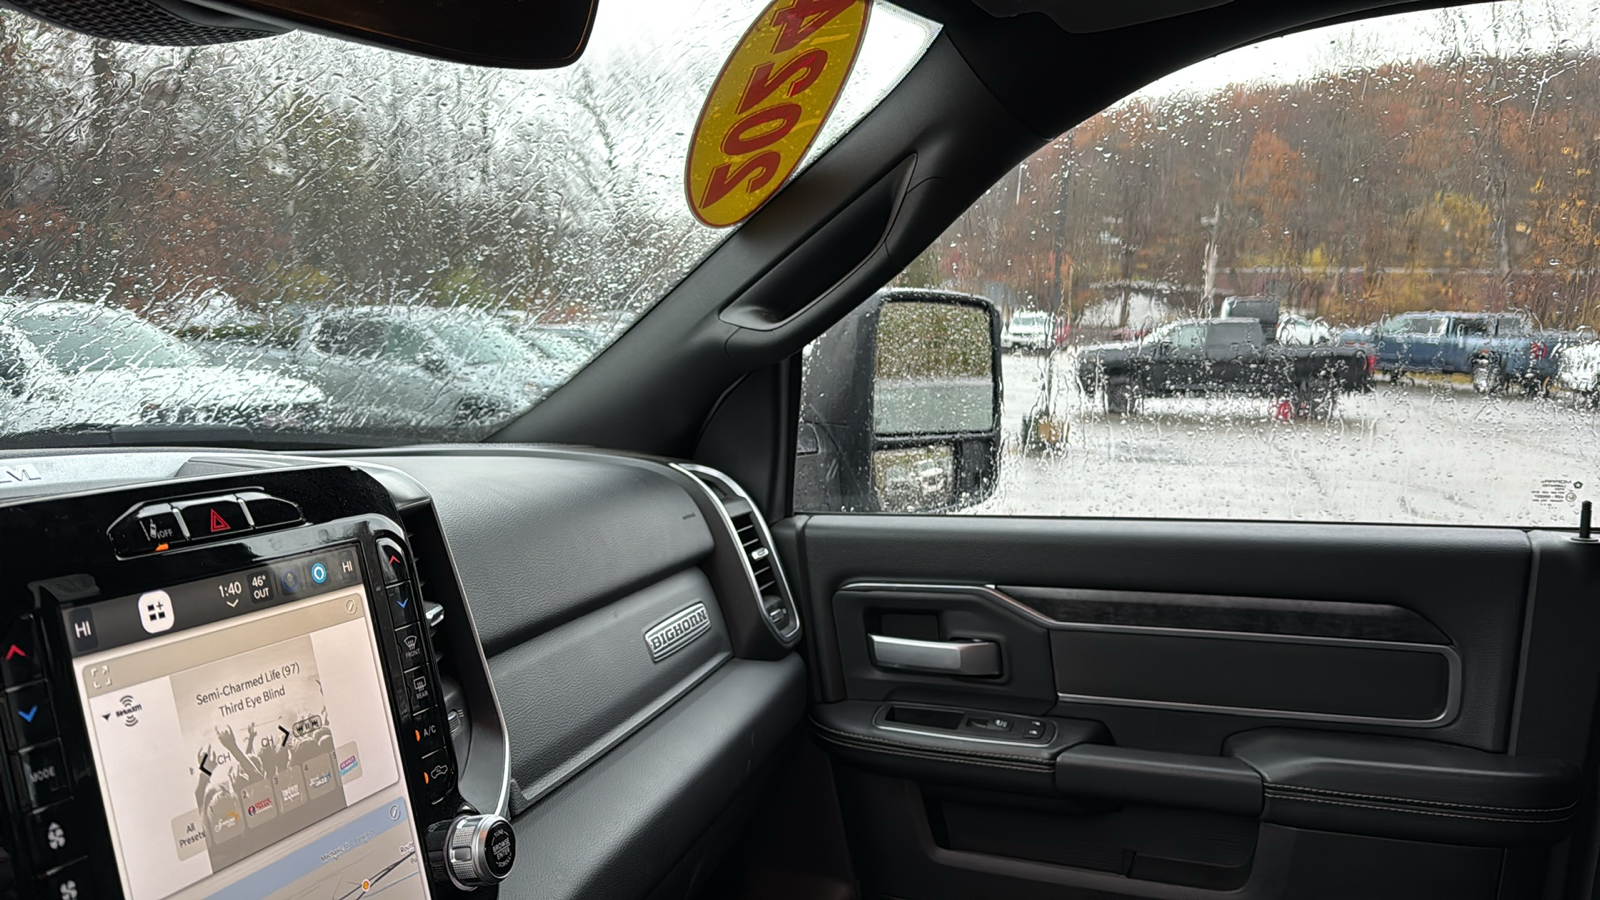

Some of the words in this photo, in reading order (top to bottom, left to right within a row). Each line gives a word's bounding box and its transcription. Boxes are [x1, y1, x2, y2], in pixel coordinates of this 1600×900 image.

[160, 528, 173, 539] OFF
[342, 560, 353, 573] HI
[219, 581, 242, 598] 1:40
[253, 587, 270, 599] OUT
[74, 620, 92, 639] HI
[650, 609, 708, 650] BIGHORN
[405, 648, 420, 658] FRONT
[195, 674, 264, 706] Semi-Charmed
[264, 669, 281, 683] Life
[281, 662, 300, 679] (97)
[218, 699, 244, 717] Third
[245, 695, 262, 709] Eye
[262, 685, 286, 702] Blind
[416, 690, 428, 700] REAR
[423, 725, 437, 737] A/C
[260, 735, 274, 748] CH
[217, 752, 231, 765] CH
[31, 766, 56, 782] MODE
[274, 777, 280, 786] 3
[242, 791, 248, 799] 2
[186, 823, 196, 834] All
[179, 830, 206, 848] Presets
